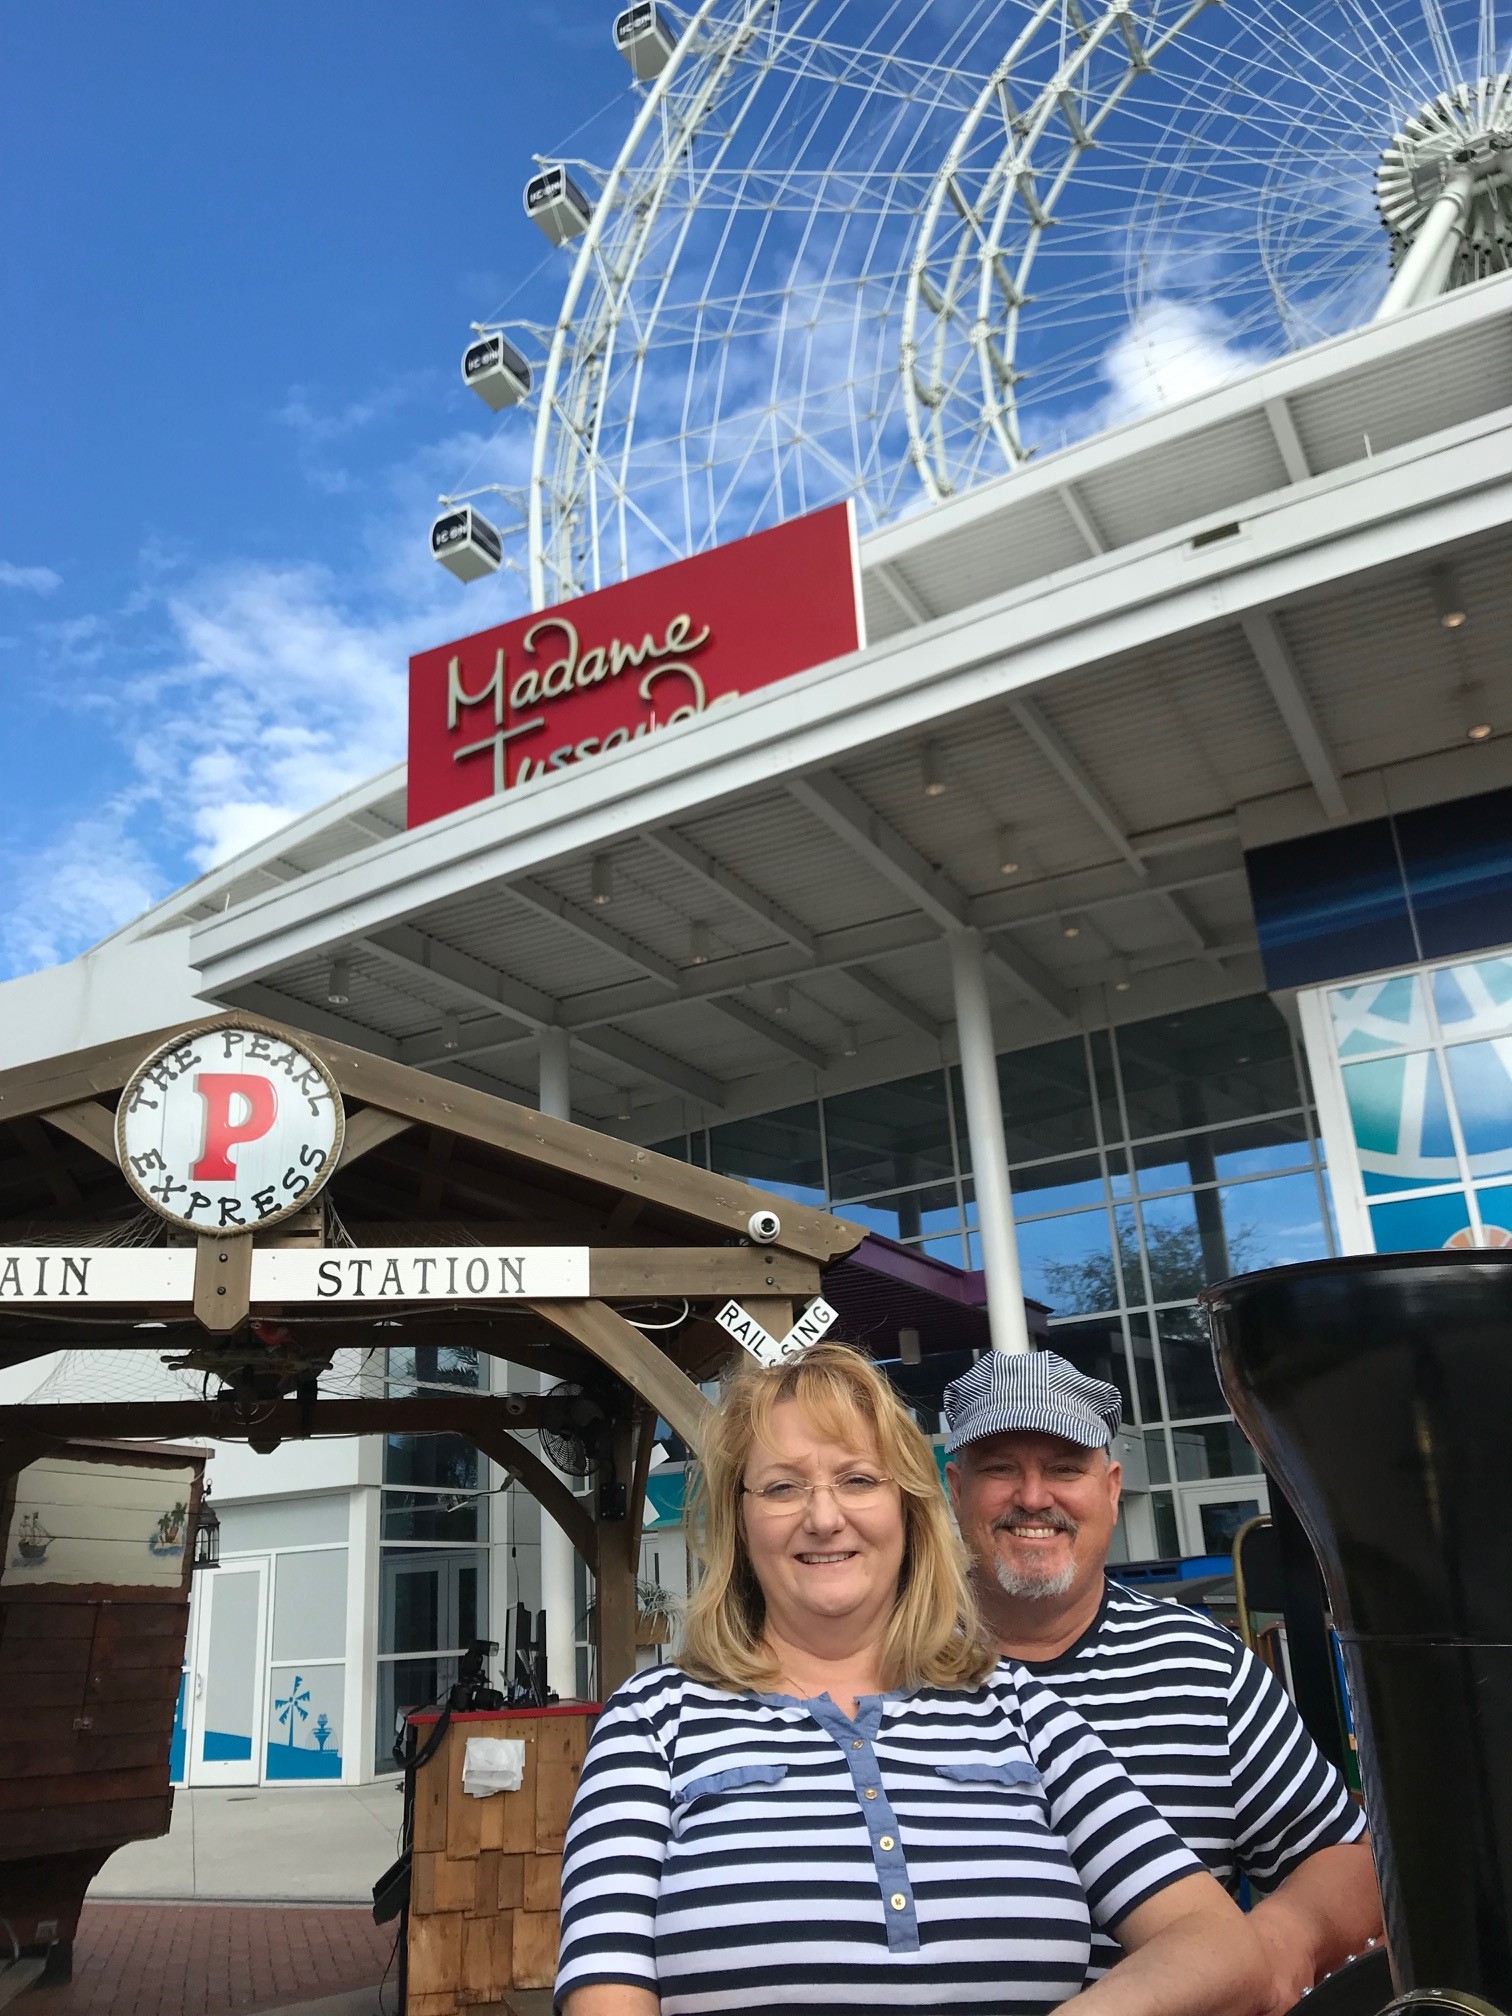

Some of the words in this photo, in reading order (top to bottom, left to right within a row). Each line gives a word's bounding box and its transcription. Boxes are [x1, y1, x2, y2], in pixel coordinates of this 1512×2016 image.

[447, 614, 710, 731] Madame
[453, 662, 741, 796] Tussad
[129, 1039, 202, 1113] THE
[221, 1029, 332, 1117] PEARL
[187, 1073, 279, 1182] P
[129, 1144, 327, 1227] EXPRESS
[317, 1257, 526, 1297] STATION
[720, 1304, 766, 1357] RAIL
